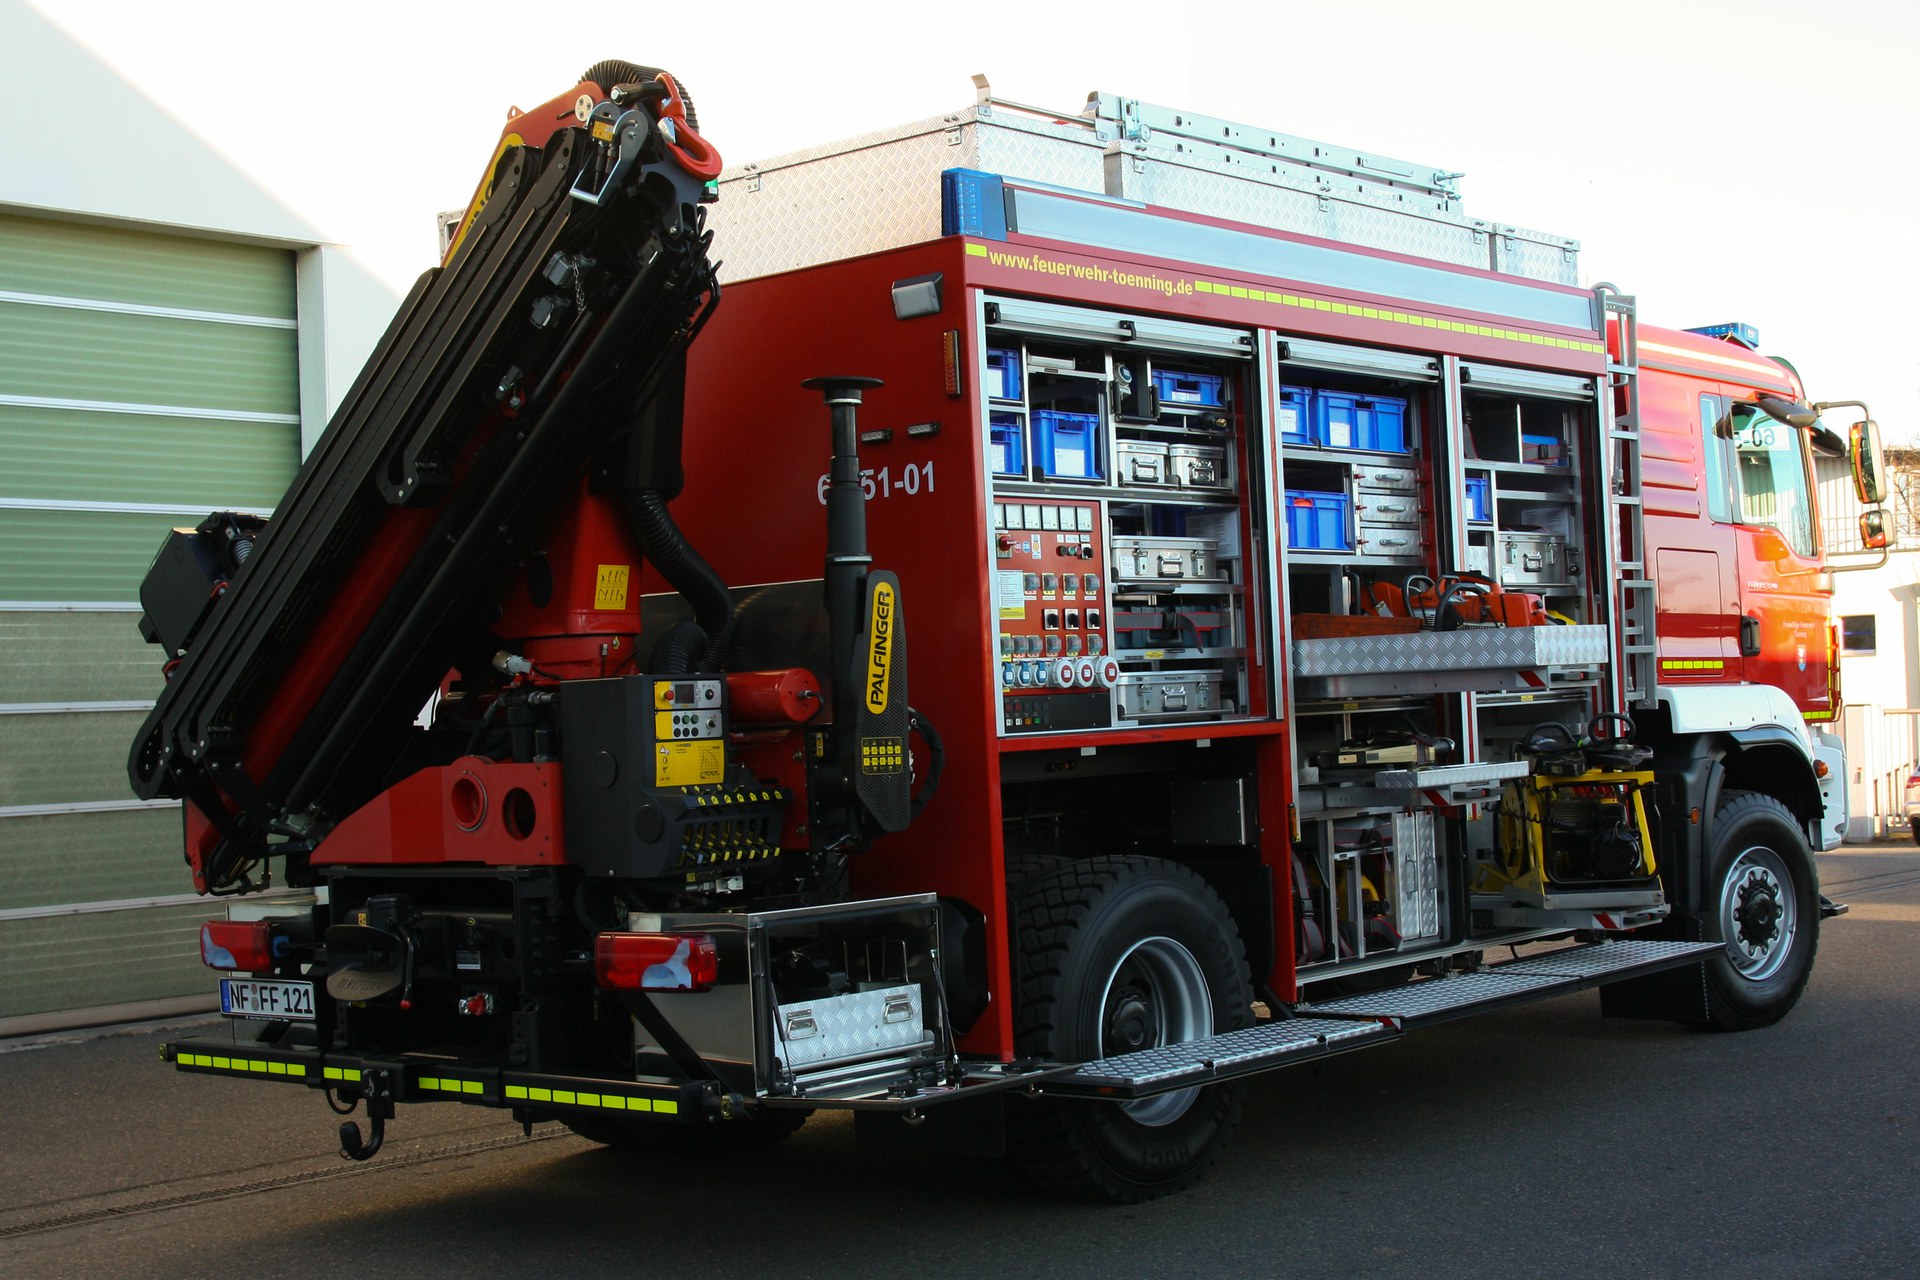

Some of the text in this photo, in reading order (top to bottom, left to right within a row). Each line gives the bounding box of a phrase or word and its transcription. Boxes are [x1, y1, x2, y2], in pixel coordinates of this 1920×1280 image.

[989, 251, 1193, 296] www.feuerwehr-toenning.de
[871, 590, 891, 706] PALFINGER
[230, 984, 314, 1014] NF FF 121
